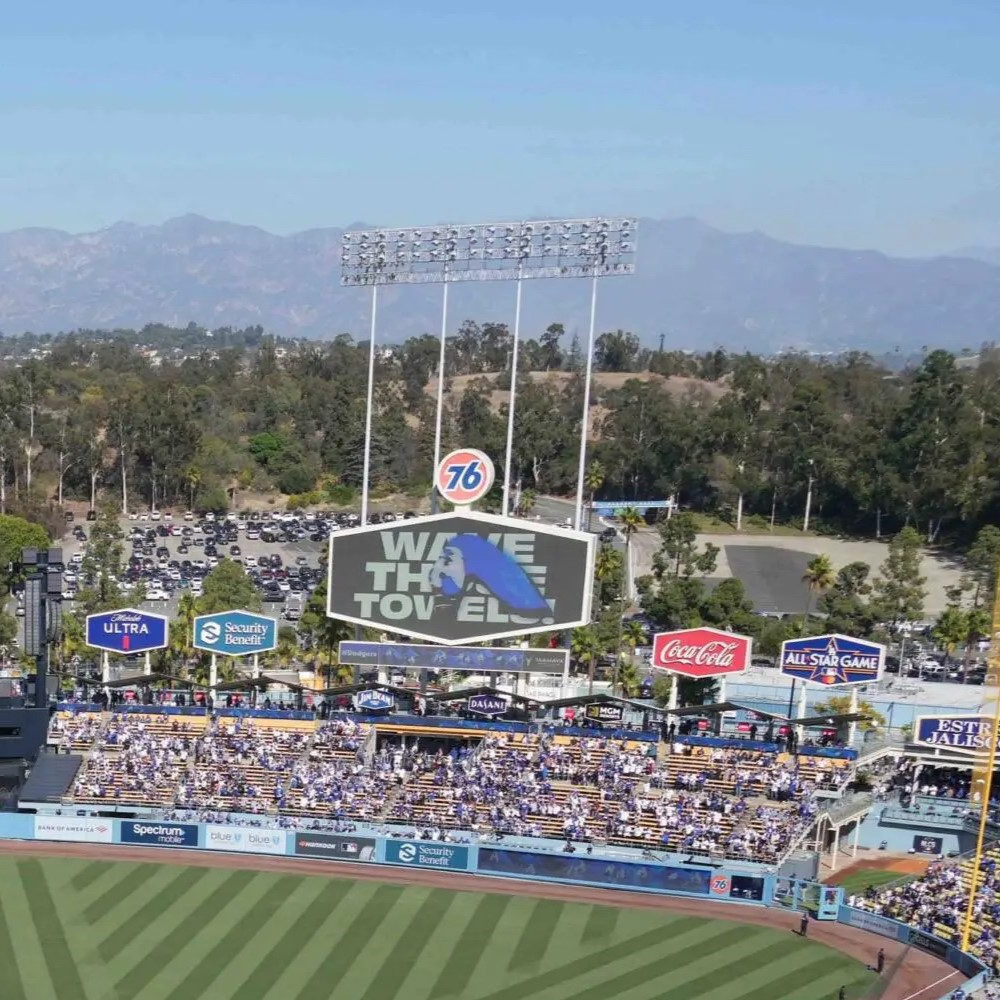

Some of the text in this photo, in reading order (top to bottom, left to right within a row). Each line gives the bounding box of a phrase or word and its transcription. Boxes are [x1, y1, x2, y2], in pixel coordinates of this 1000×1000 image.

[444, 461, 483, 491] 76
[379, 531, 536, 564] WAE
[365, 562, 547, 596] THE
[103, 623, 149, 635] ULTRA
[225, 622, 268, 635] Security
[225, 634, 262, 646] Benefit
[660, 638, 739, 667] Coca-Cola
[786, 653, 878, 669] ALL STAR GAME
[471, 700, 505, 709] DASANI
[600, 707, 621, 715] MGM
[937, 719, 993, 735] ESTR
[133, 824, 182, 837] Spectrum
[211, 831, 231, 840] blue
[249, 835, 270, 844] blue
[419, 845, 455, 857] Security
[419, 854, 449, 866] Benefit
[713, 880, 727, 889] 76
